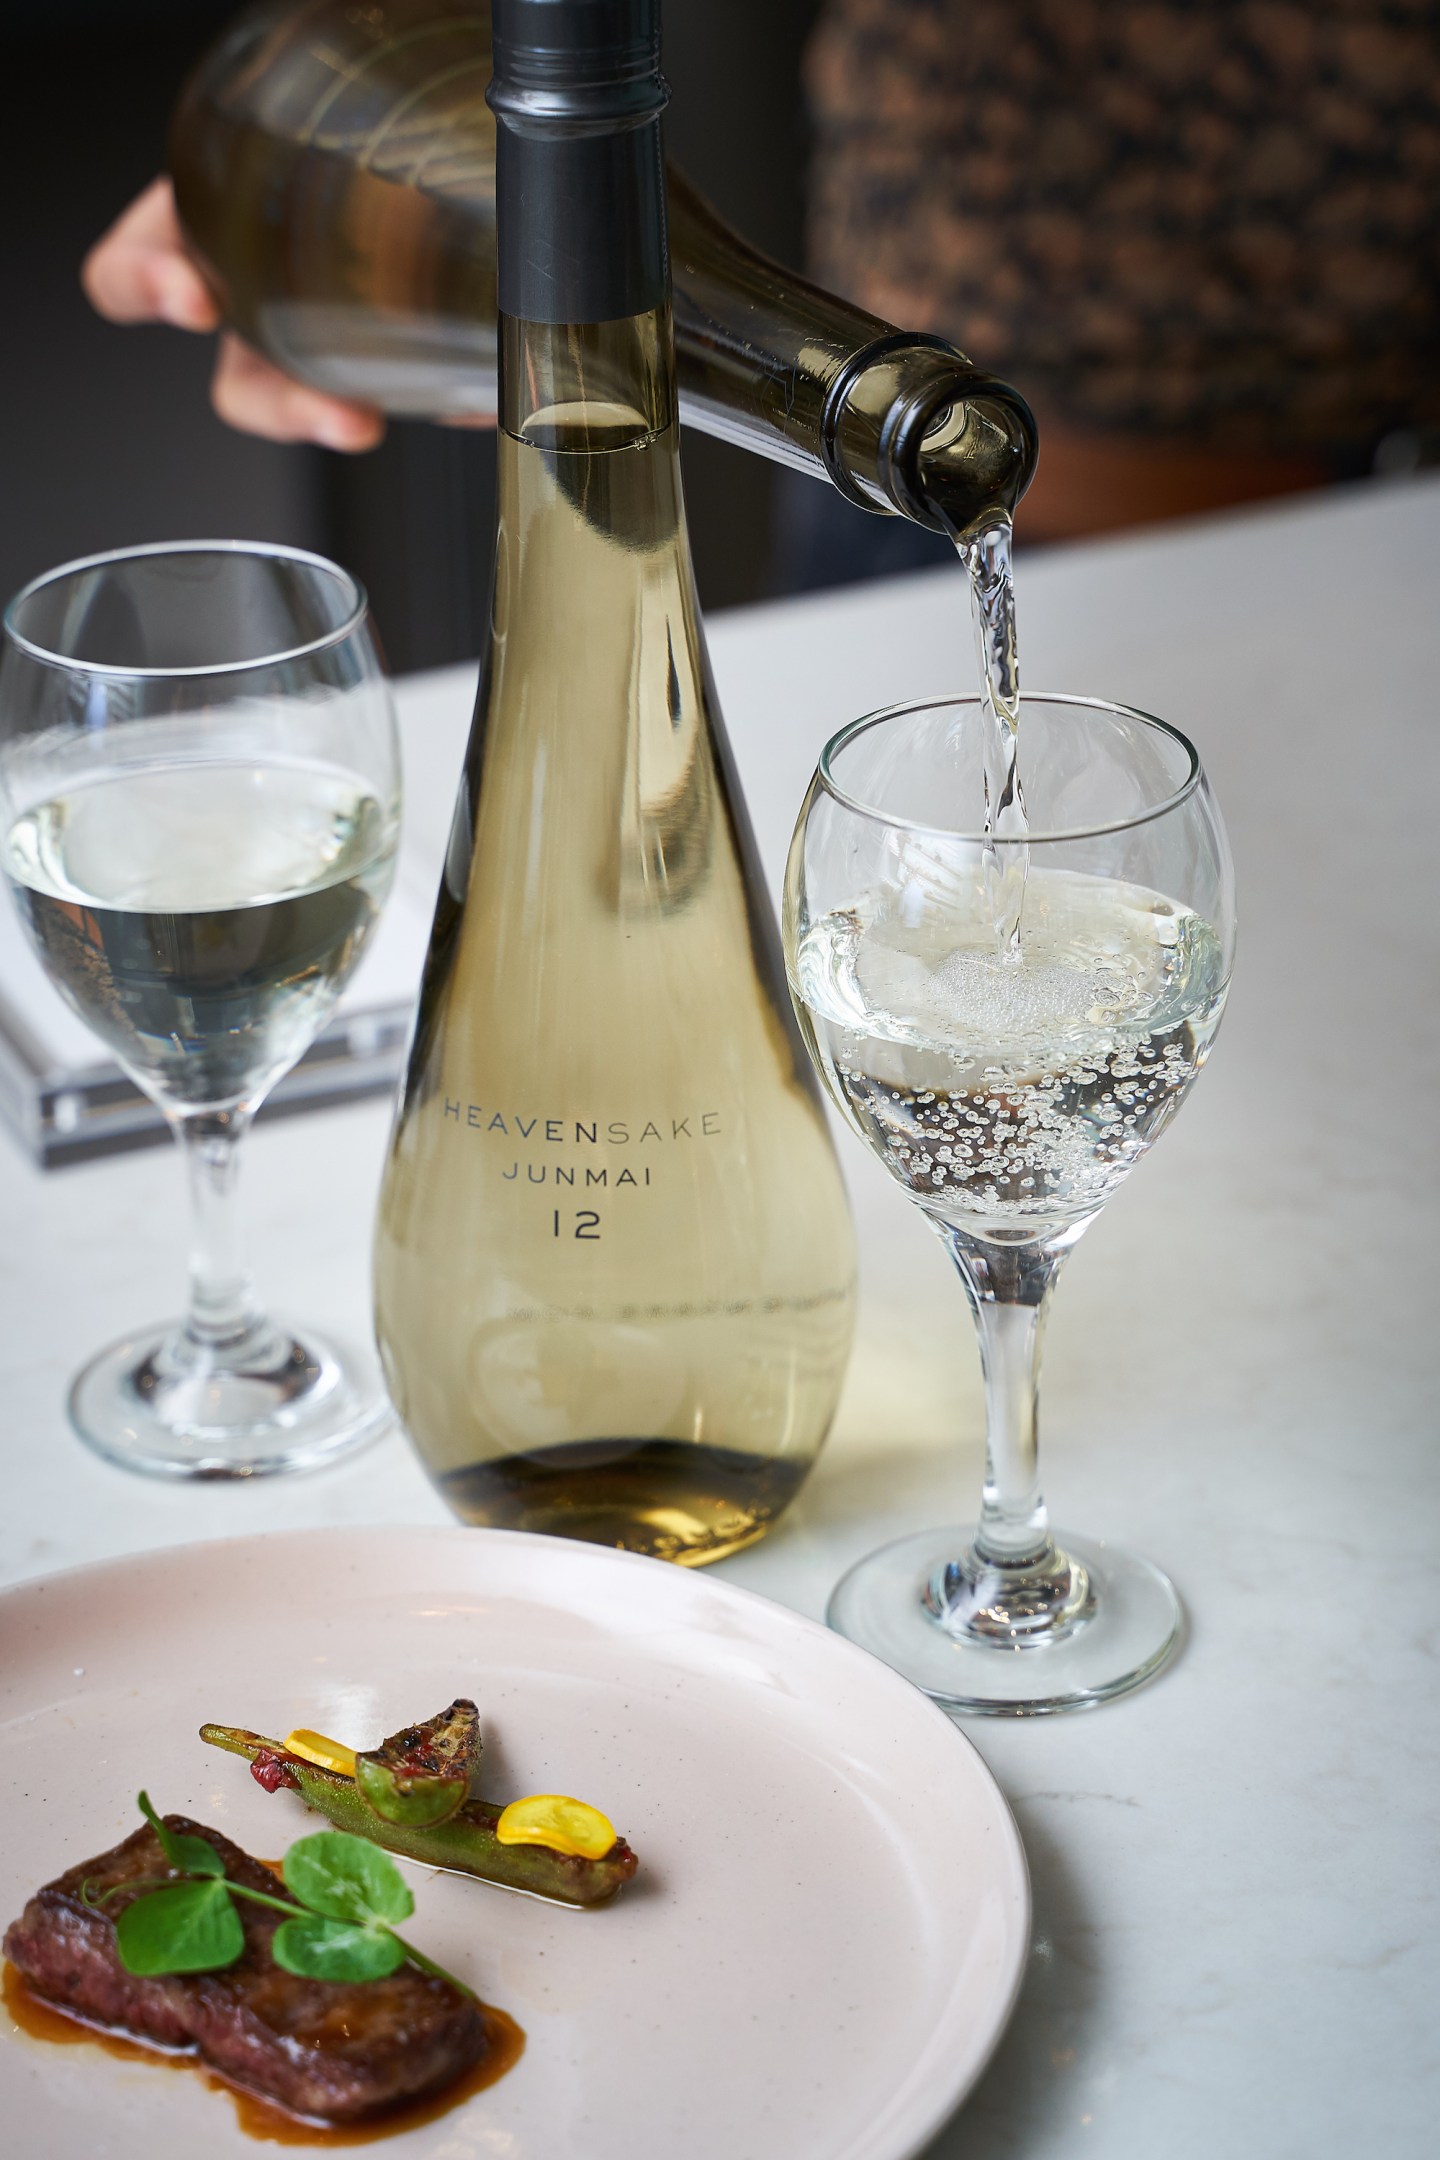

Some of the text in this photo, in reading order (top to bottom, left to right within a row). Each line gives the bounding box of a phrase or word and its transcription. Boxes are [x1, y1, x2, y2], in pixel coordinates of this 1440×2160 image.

[443, 1097, 722, 1145] HEAVENSAKE
[502, 1162, 651, 1187] JUNMAI
[554, 1209, 601, 1240] 12
